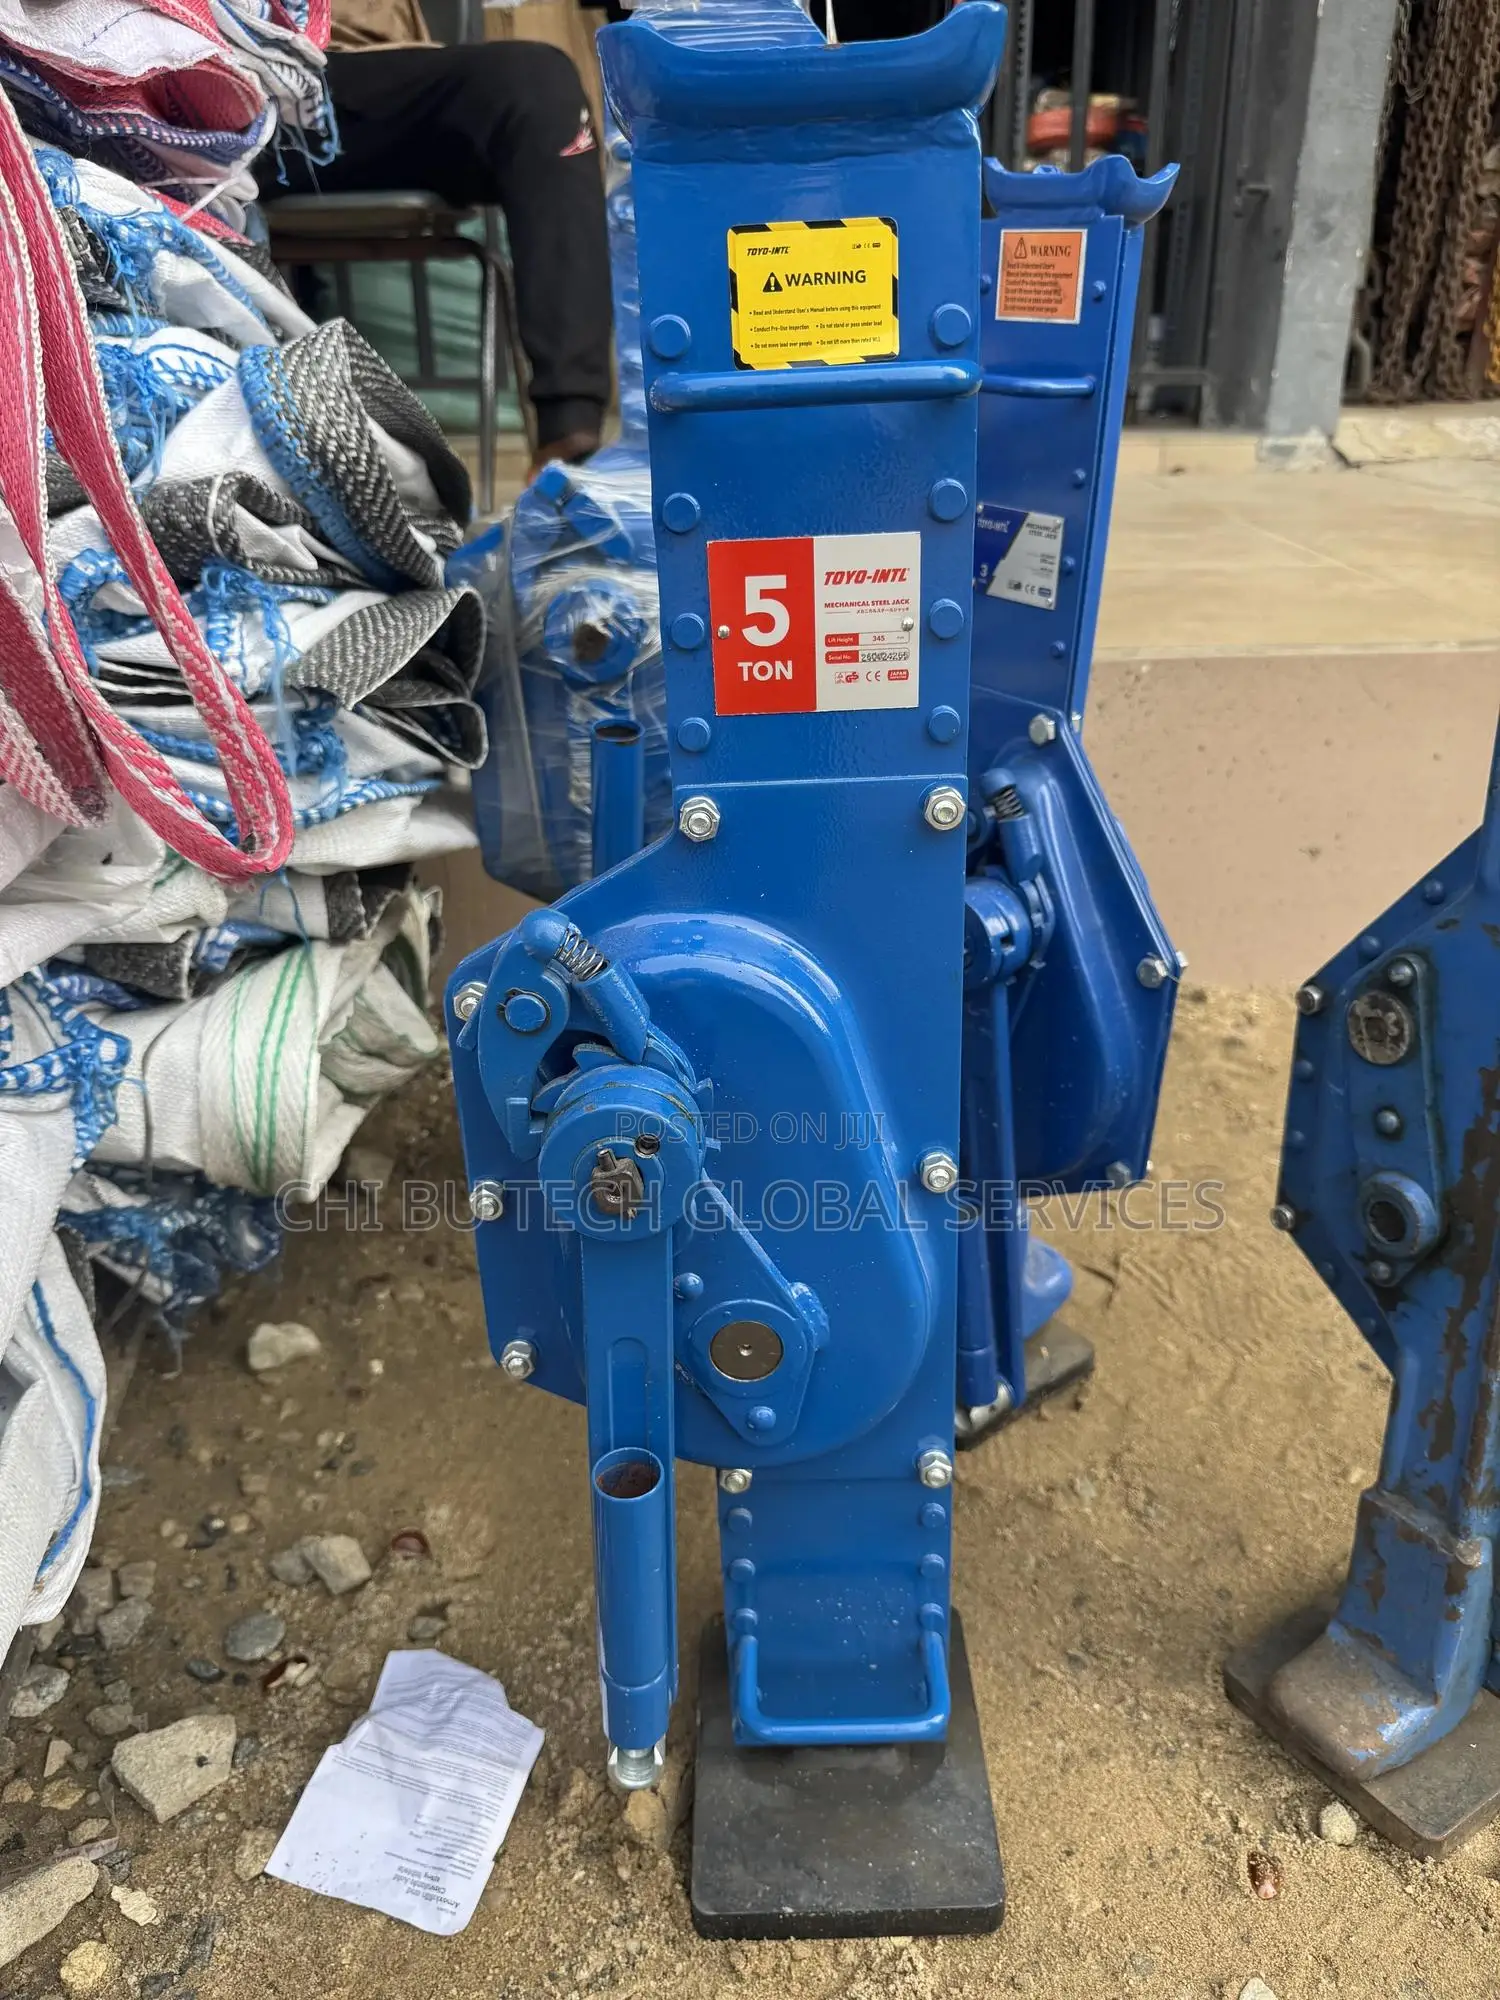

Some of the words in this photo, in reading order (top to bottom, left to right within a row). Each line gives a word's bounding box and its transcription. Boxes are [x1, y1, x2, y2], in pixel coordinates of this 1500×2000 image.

[747, 246, 789, 256] TOYO-INTL
[1030, 244, 1072, 257] WARNING
[785, 270, 867, 287] WARNING
[833, 321, 845, 329] stand
[824, 568, 908, 586] TOYO-INTL
[980, 564, 988, 577] 3
[742, 575, 790, 647] 5
[824, 600, 870, 609] MECHANICAL
[738, 660, 793, 682] TON
